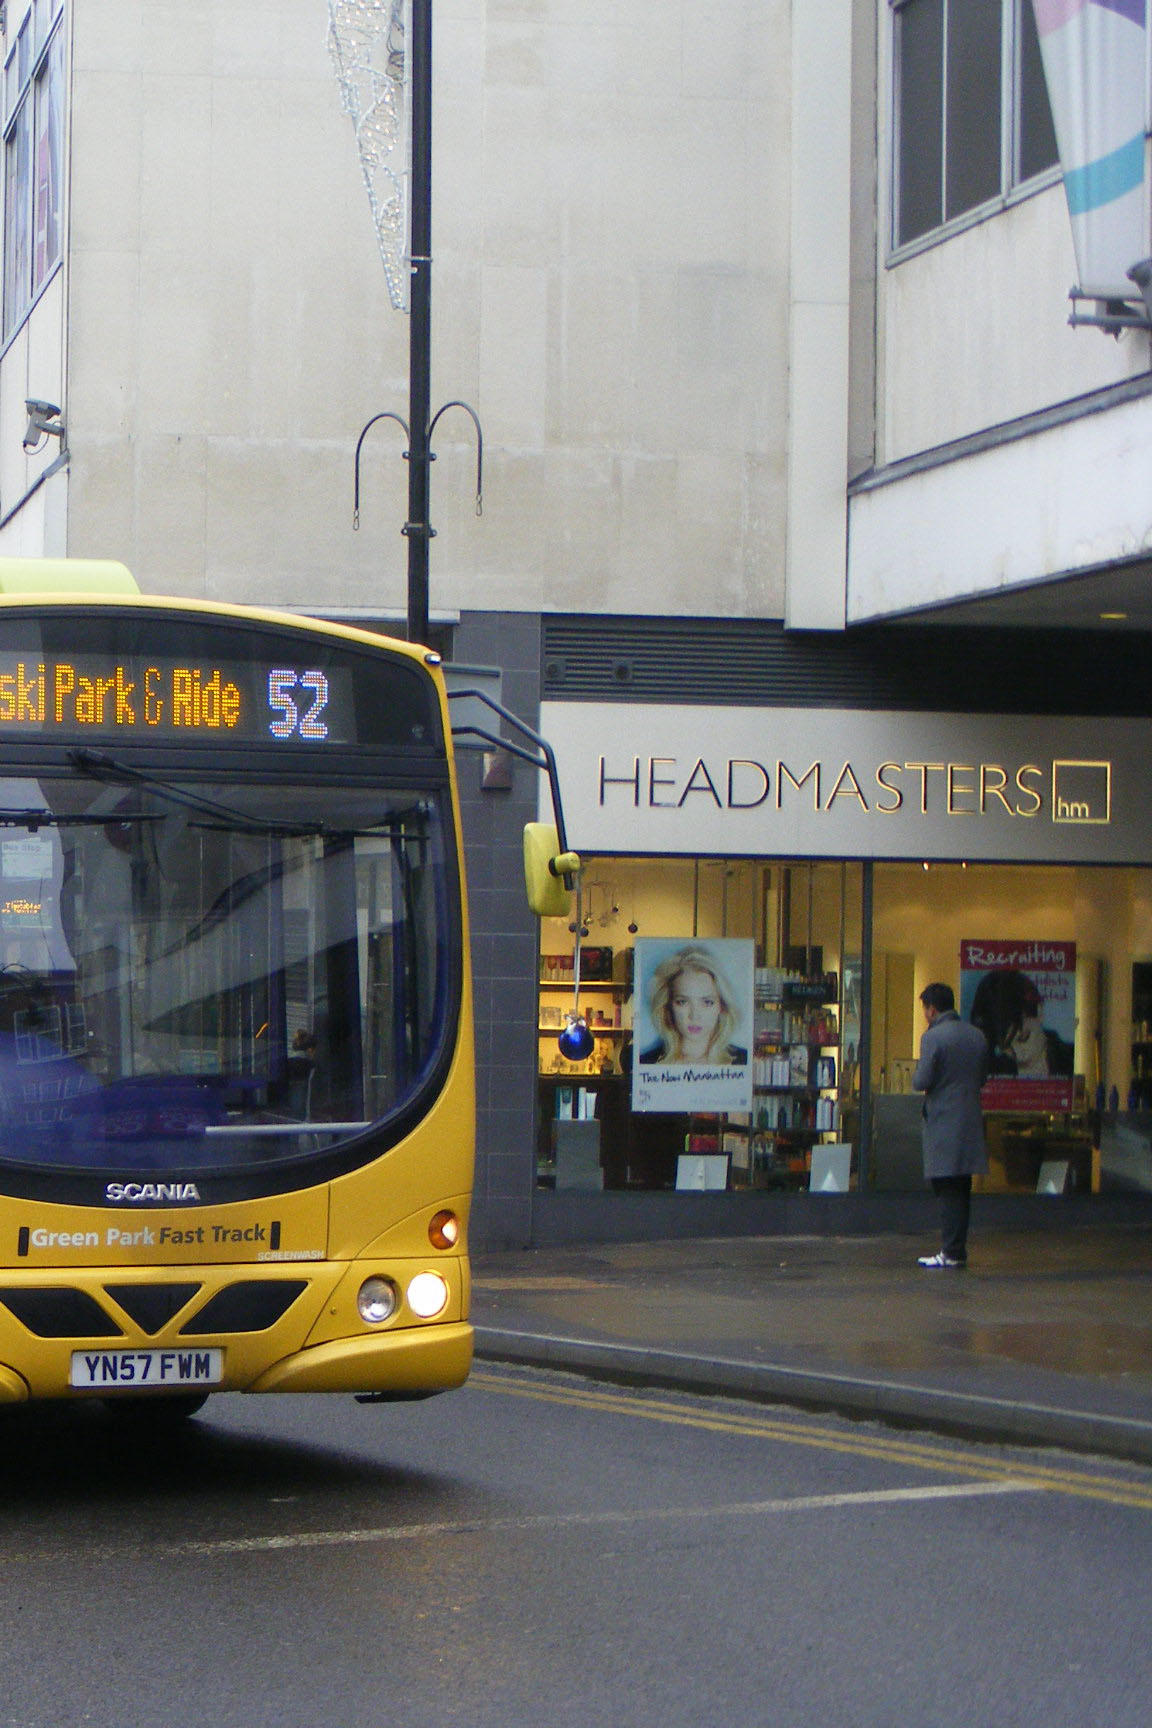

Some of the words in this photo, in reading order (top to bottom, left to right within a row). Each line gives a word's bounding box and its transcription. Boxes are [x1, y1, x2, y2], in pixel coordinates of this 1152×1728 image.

[55, 664, 136, 725] Park
[173, 668, 240, 727] Ride
[268, 668, 329, 739] 52
[598, 755, 1043, 817] HEADMASTERS
[1057, 800, 1090, 818] hm
[967, 943, 1065, 970] Recruiting
[639, 1072, 659, 1083] The
[683, 1068, 745, 1082] Manhattan
[106, 1182, 200, 1201] SCANIA
[31, 1228, 99, 1247] Green
[106, 1226, 156, 1246] Park
[159, 1225, 205, 1245] Fast
[212, 1222, 266, 1243] Track
[257, 1250, 325, 1261] SCREENWASH
[85, 1354, 153, 1382] YN57
[160, 1353, 211, 1379] FWM
